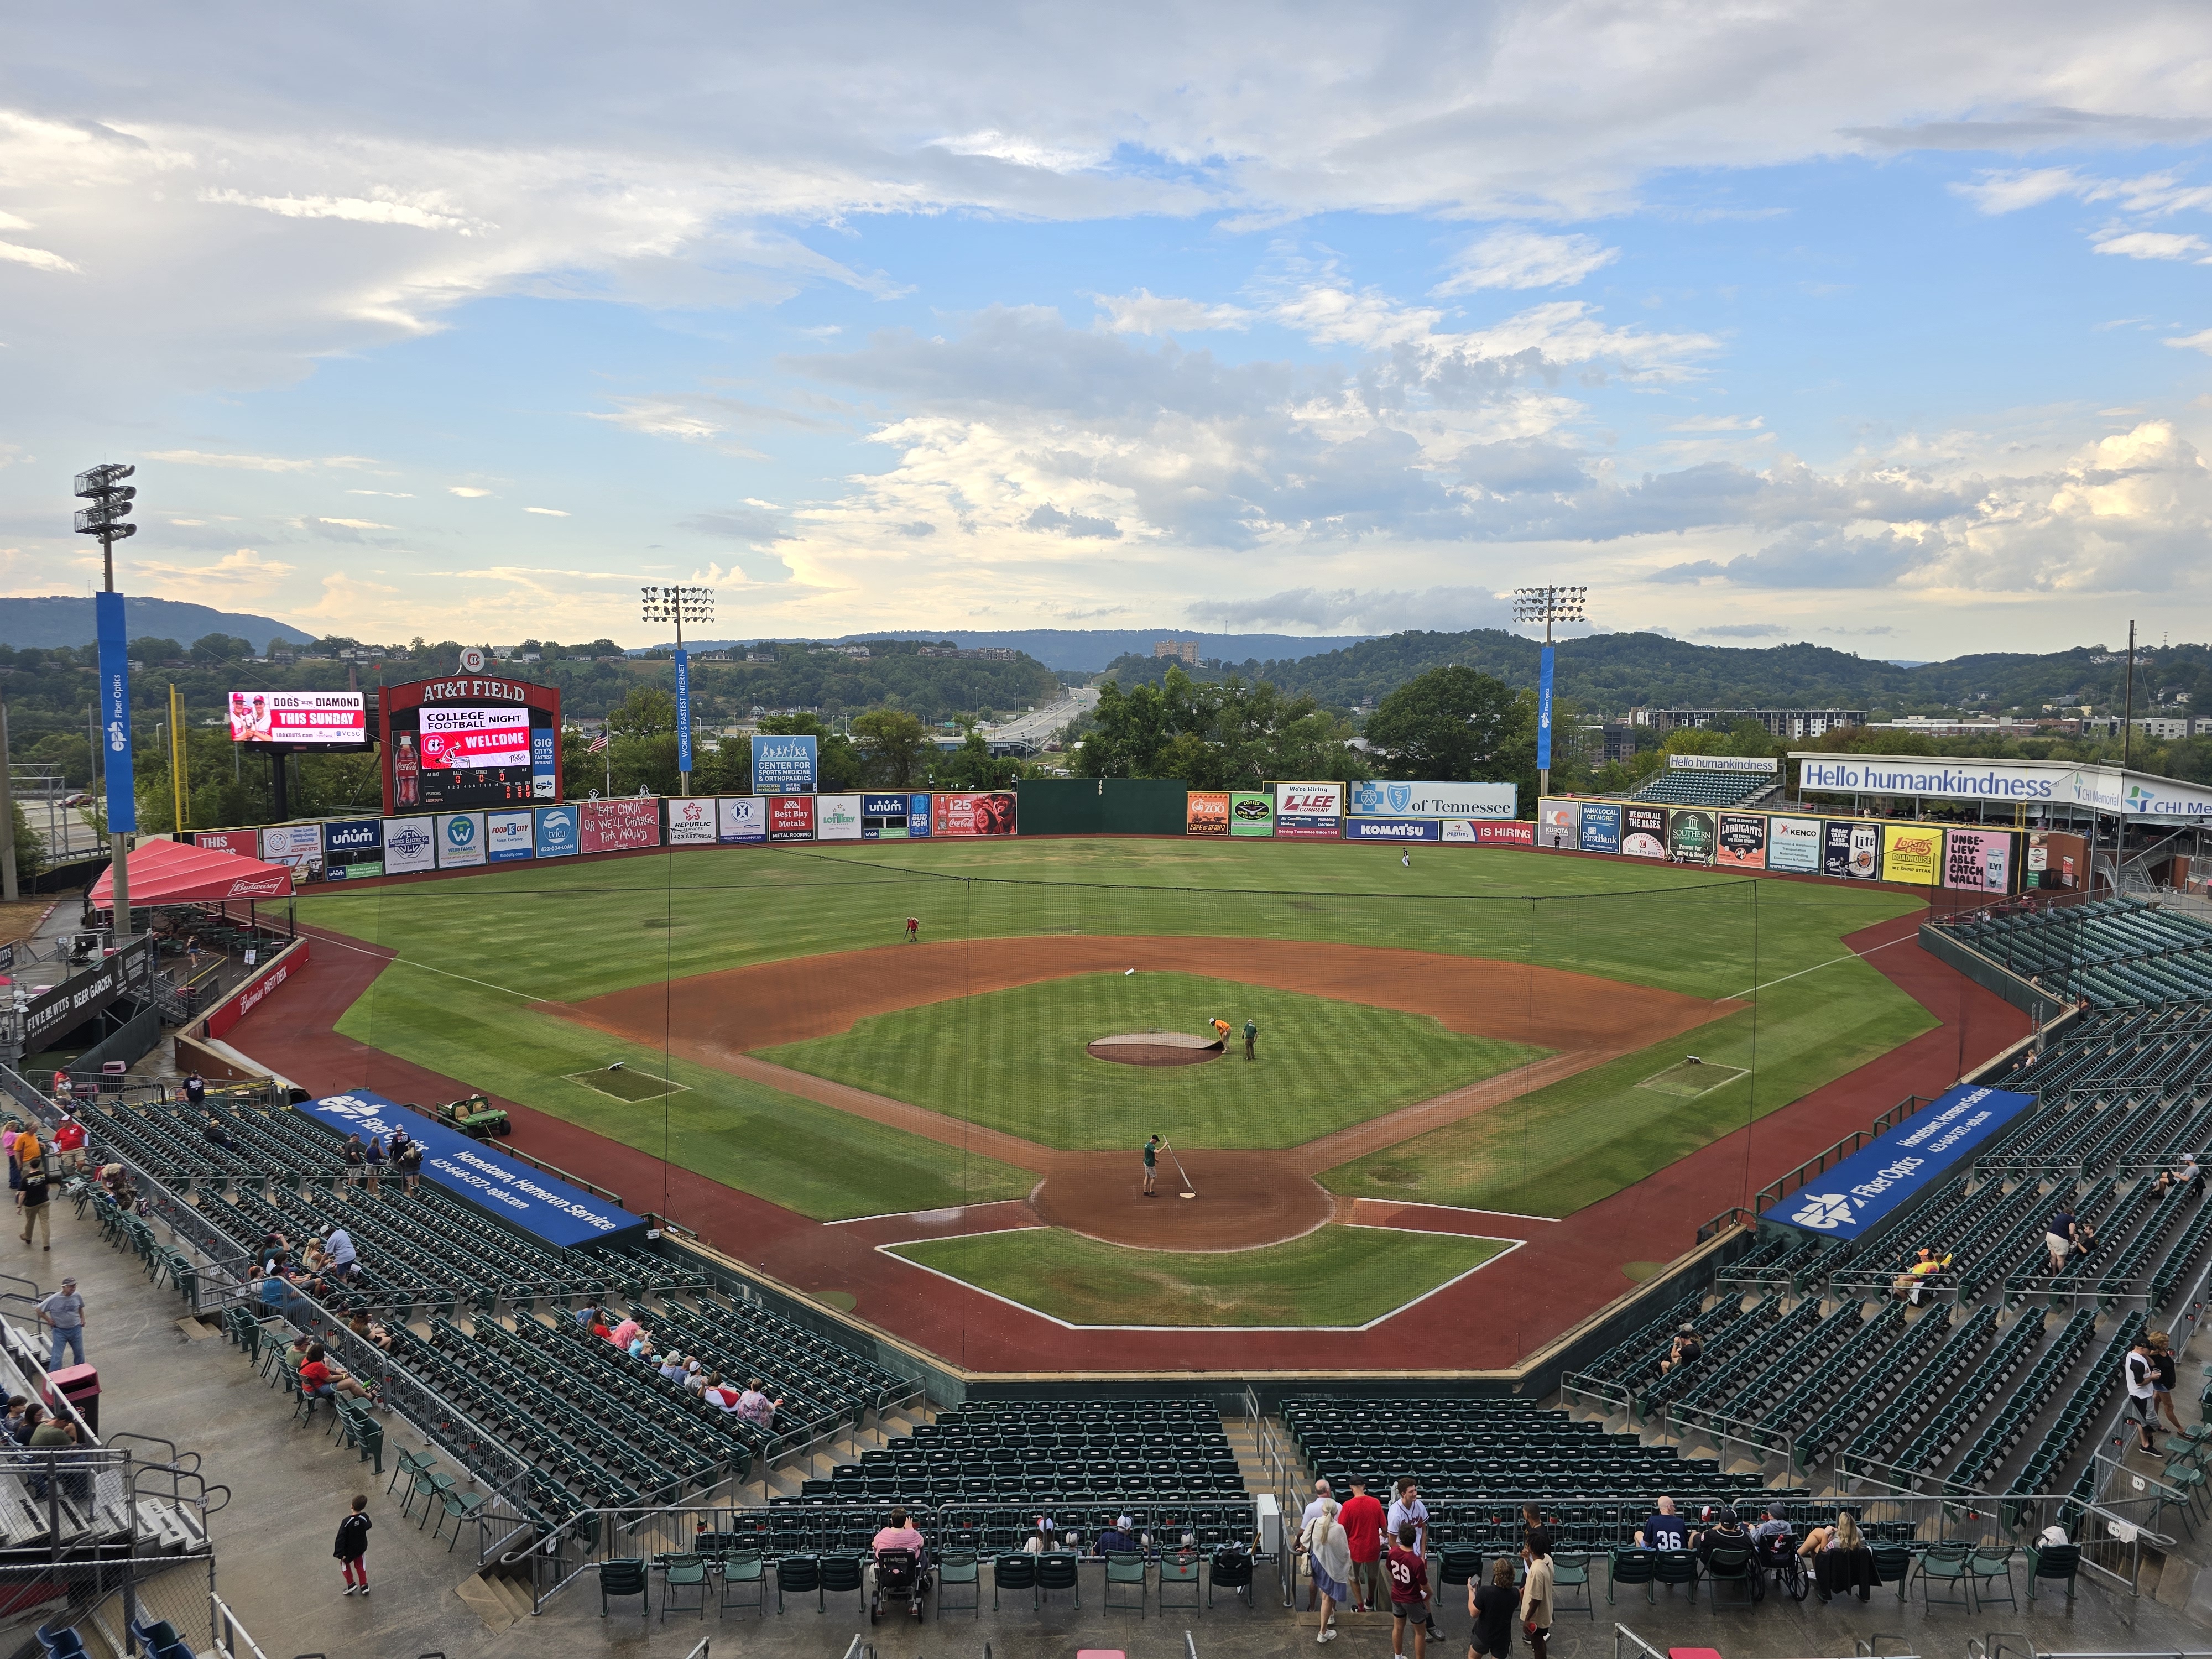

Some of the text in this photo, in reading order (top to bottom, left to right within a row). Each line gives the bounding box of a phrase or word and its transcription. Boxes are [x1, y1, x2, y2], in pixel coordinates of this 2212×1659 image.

[423, 681, 525, 702] AT&T FIELD
[274, 698, 299, 707] DOGS
[316, 698, 359, 707] DIAMOND
[107, 674, 127, 752] epb Fiber Optics
[280, 713, 354, 725] THIS SUNDAY
[427, 712, 485, 722] COLLEGE
[428, 721, 486, 730] FOOTBALL
[465, 732, 525, 748] WELCOME
[534, 738, 552, 747] GIG
[1671, 756, 1773, 770] Hello humankindness
[1807, 764, 2052, 797] Hello humankindness
[1301, 795, 1336, 807] LEE
[2082, 789, 2119, 806] CHI Memorial
[598, 802, 641, 817] EAT CHIKIN
[869, 800, 901, 811] unum
[1204, 805, 1225, 813] ZOO
[1412, 800, 1511, 813] of Tennessee
[2154, 802, 2182, 813] CHI
[584, 814, 655, 830] OR WE'LL CHARGE
[823, 813, 855, 823] LOTTERY
[1637, 811, 1651, 820] COVER
[1629, 818, 1640, 827] THE
[333, 828, 372, 844] unum
[549, 828, 565, 838] tvfcu
[600, 828, 648, 843] THA MOUND
[1361, 823, 1424, 836] KOMATSU
[1481, 827, 1531, 839] IS HIRING
[1672, 829, 1710, 838] SOUTHERN
[1722, 823, 1762, 837] LUBRICANTS
[201, 836, 227, 848] THIS
[1854, 835, 1874, 849] Lite
[1893, 836, 1933, 855] Logan's
[1952, 834, 1984, 845] UNBE-
[1951, 844, 1979, 854] LIEV-
[1892, 853, 1931, 864] ROADHOUSE
[1950, 855, 1976, 865] ABLE
[1949, 865, 1984, 875] CATCH
[1949, 874, 1983, 885] WALL.
[232, 880, 278, 893] Budweiser
[264, 965, 287, 995] PARTY DECK
[74, 988, 90, 1009] BEER
[90, 974, 112, 999] GARDEN
[28, 997, 69, 1031] FIVE WITS
[1896, 1088, 1993, 1147] Hometown, Homerun Service
[356, 1117, 394, 1134] Fiber
[1927, 1110, 1992, 1152] 423-648-1372 epb.com
[430, 1158, 530, 1209] 423-648-1372 epb.com
[1850, 1156, 1925, 1198] Fiber Optics
[452, 1151, 617, 1230] Hometown, Homerun Service
[1656, 1531, 1681, 1550] 36
[1390, 1559, 1411, 1584] 29
